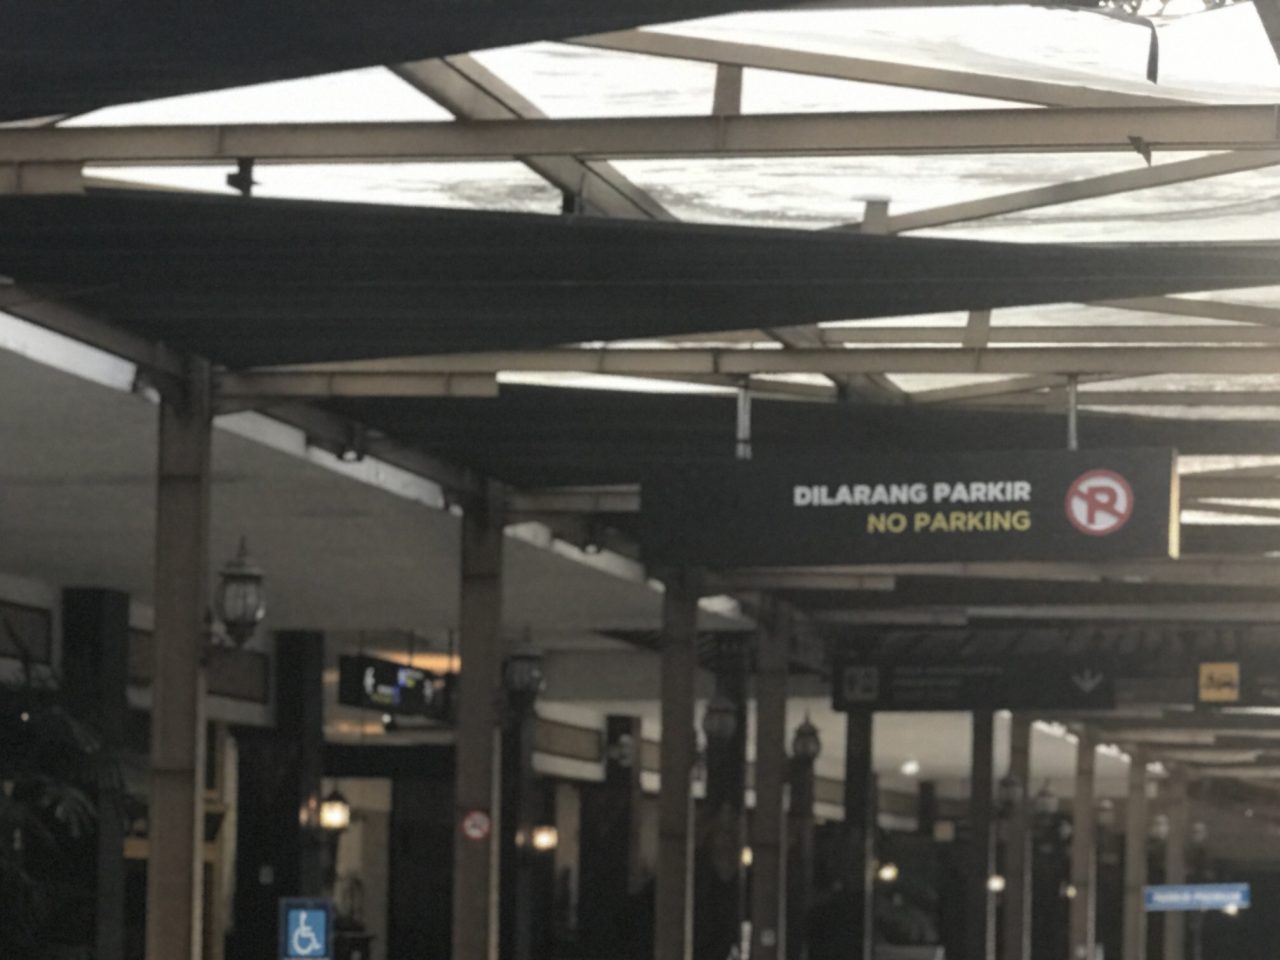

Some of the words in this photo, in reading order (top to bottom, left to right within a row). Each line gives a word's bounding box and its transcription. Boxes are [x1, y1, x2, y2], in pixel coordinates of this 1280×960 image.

[794, 482, 927, 506] DILARANG
[933, 481, 1031, 502] PARKIR
[867, 513, 907, 534] NO
[914, 510, 1032, 531] PARKING
